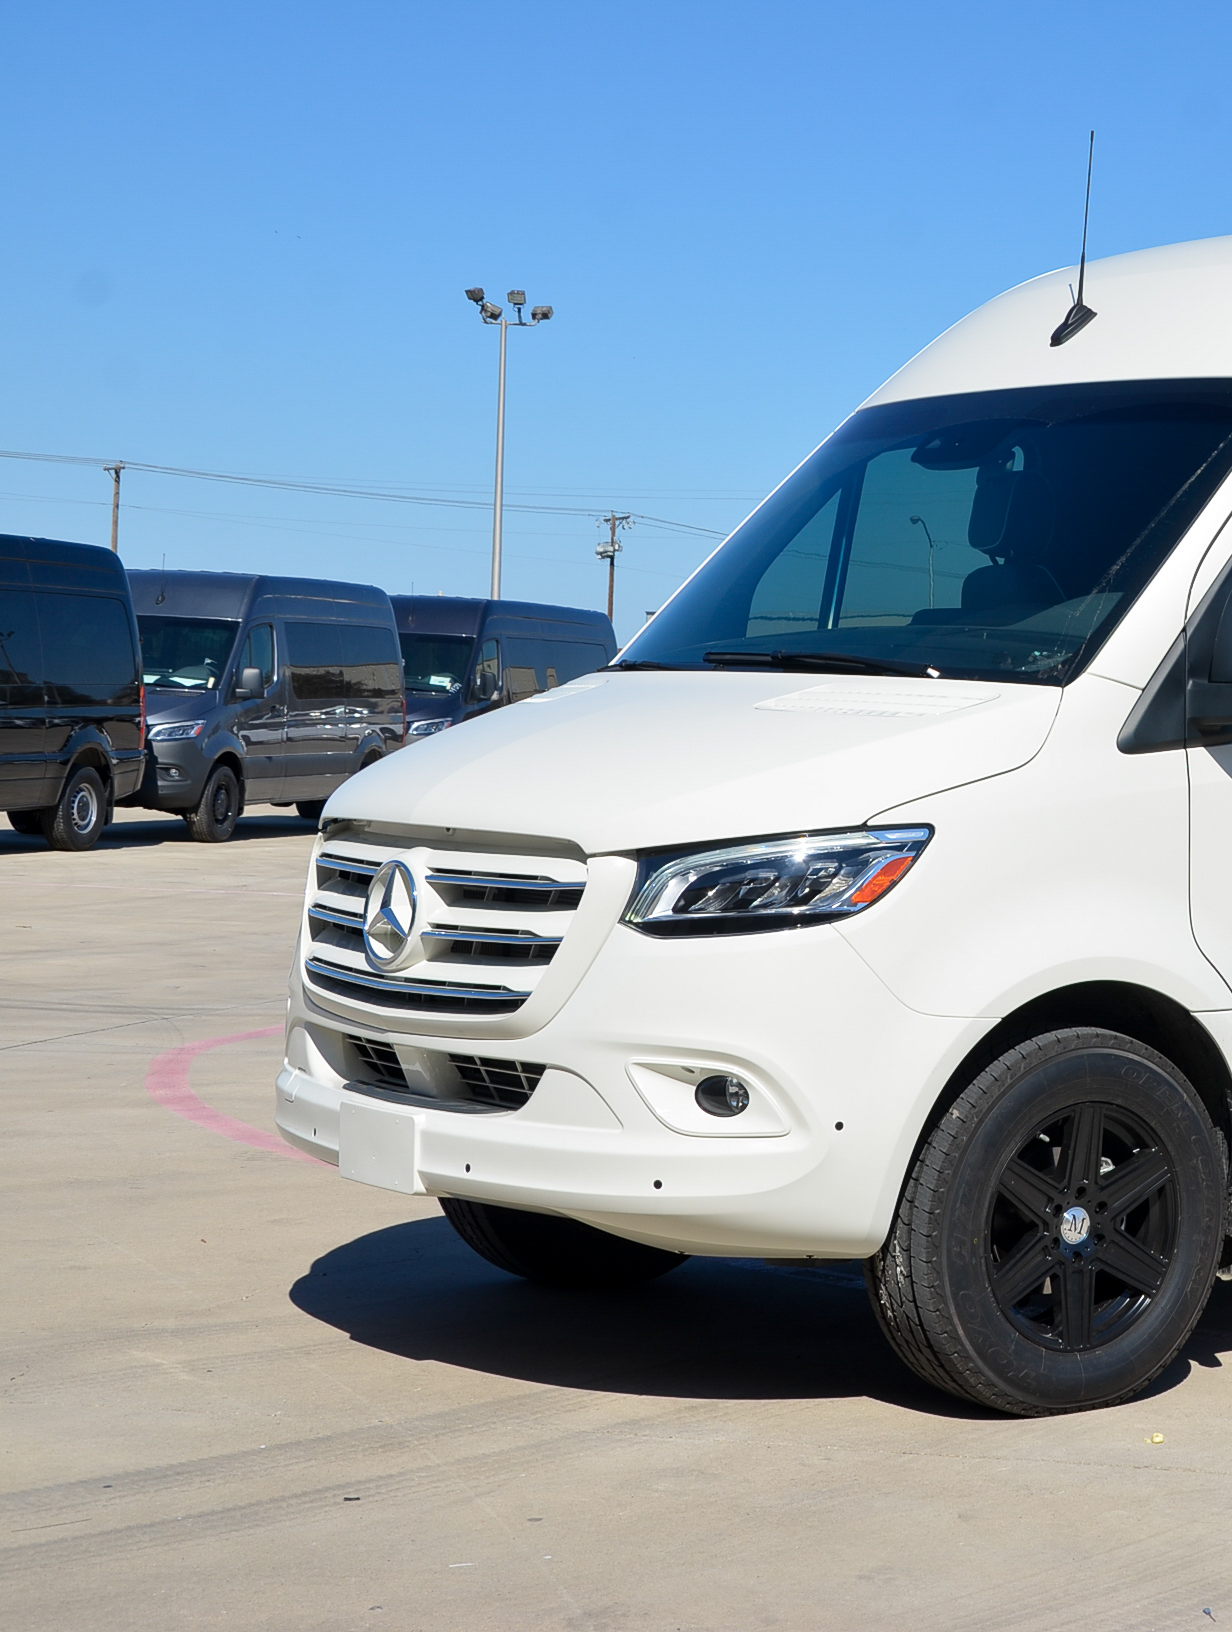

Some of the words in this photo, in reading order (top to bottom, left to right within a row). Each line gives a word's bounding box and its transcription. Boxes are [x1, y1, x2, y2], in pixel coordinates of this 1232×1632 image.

[1067, 1213, 1087, 1235] M
[1121, 1065, 1190, 1125] OPEN
[1187, 1135, 1216, 1295] COUNTRY
[958, 1290, 1037, 1387] TOYO
